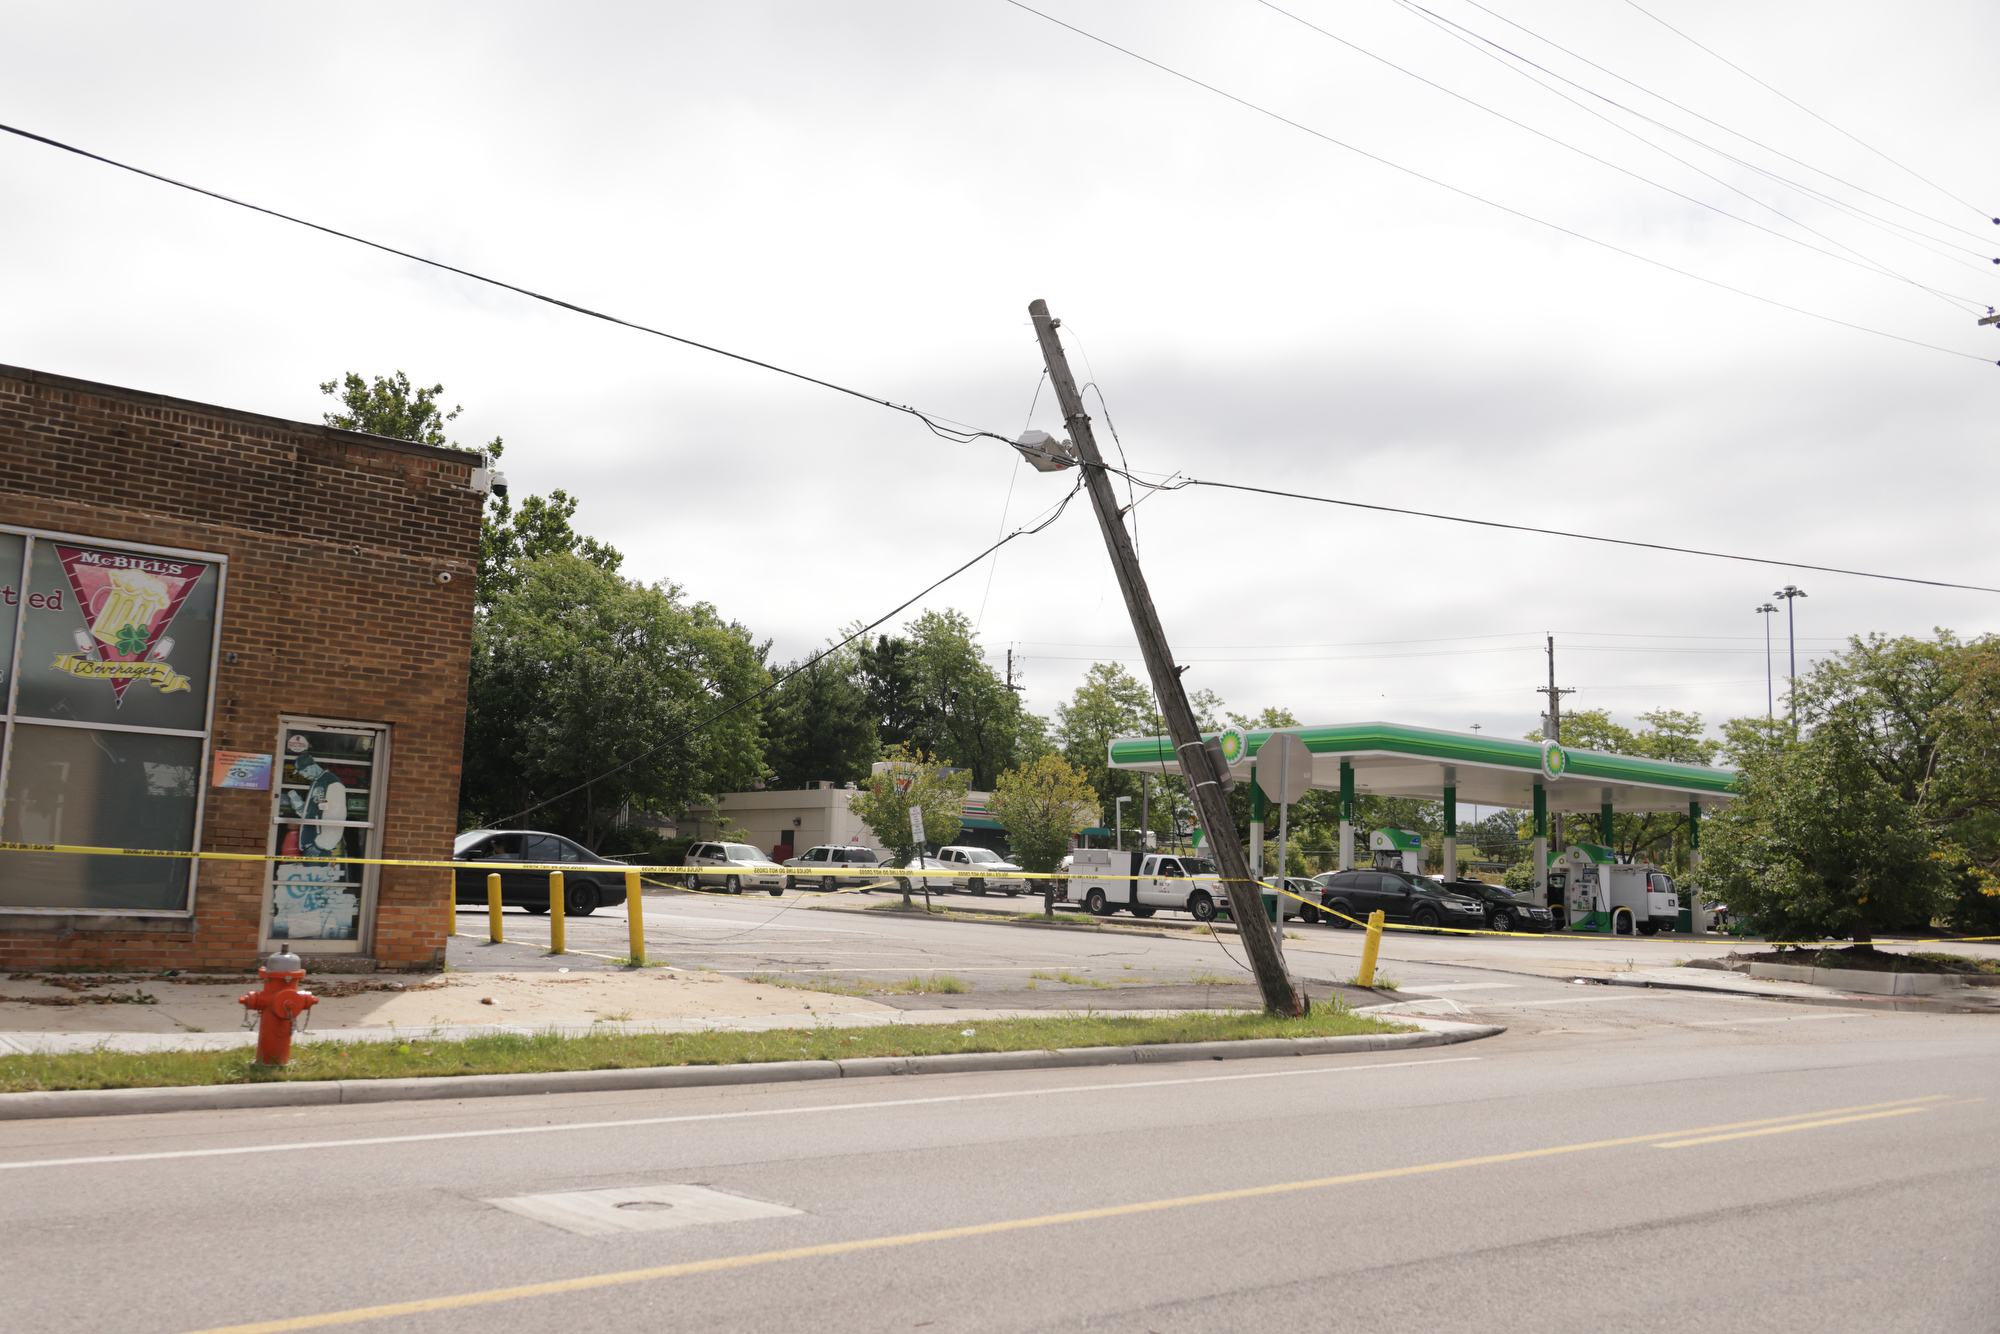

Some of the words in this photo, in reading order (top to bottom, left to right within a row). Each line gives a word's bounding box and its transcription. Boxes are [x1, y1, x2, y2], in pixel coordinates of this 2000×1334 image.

[80, 551, 183, 575] McBILL'S
[0, 585, 64, 611] ted
[74, 661, 165, 682] Beverages
